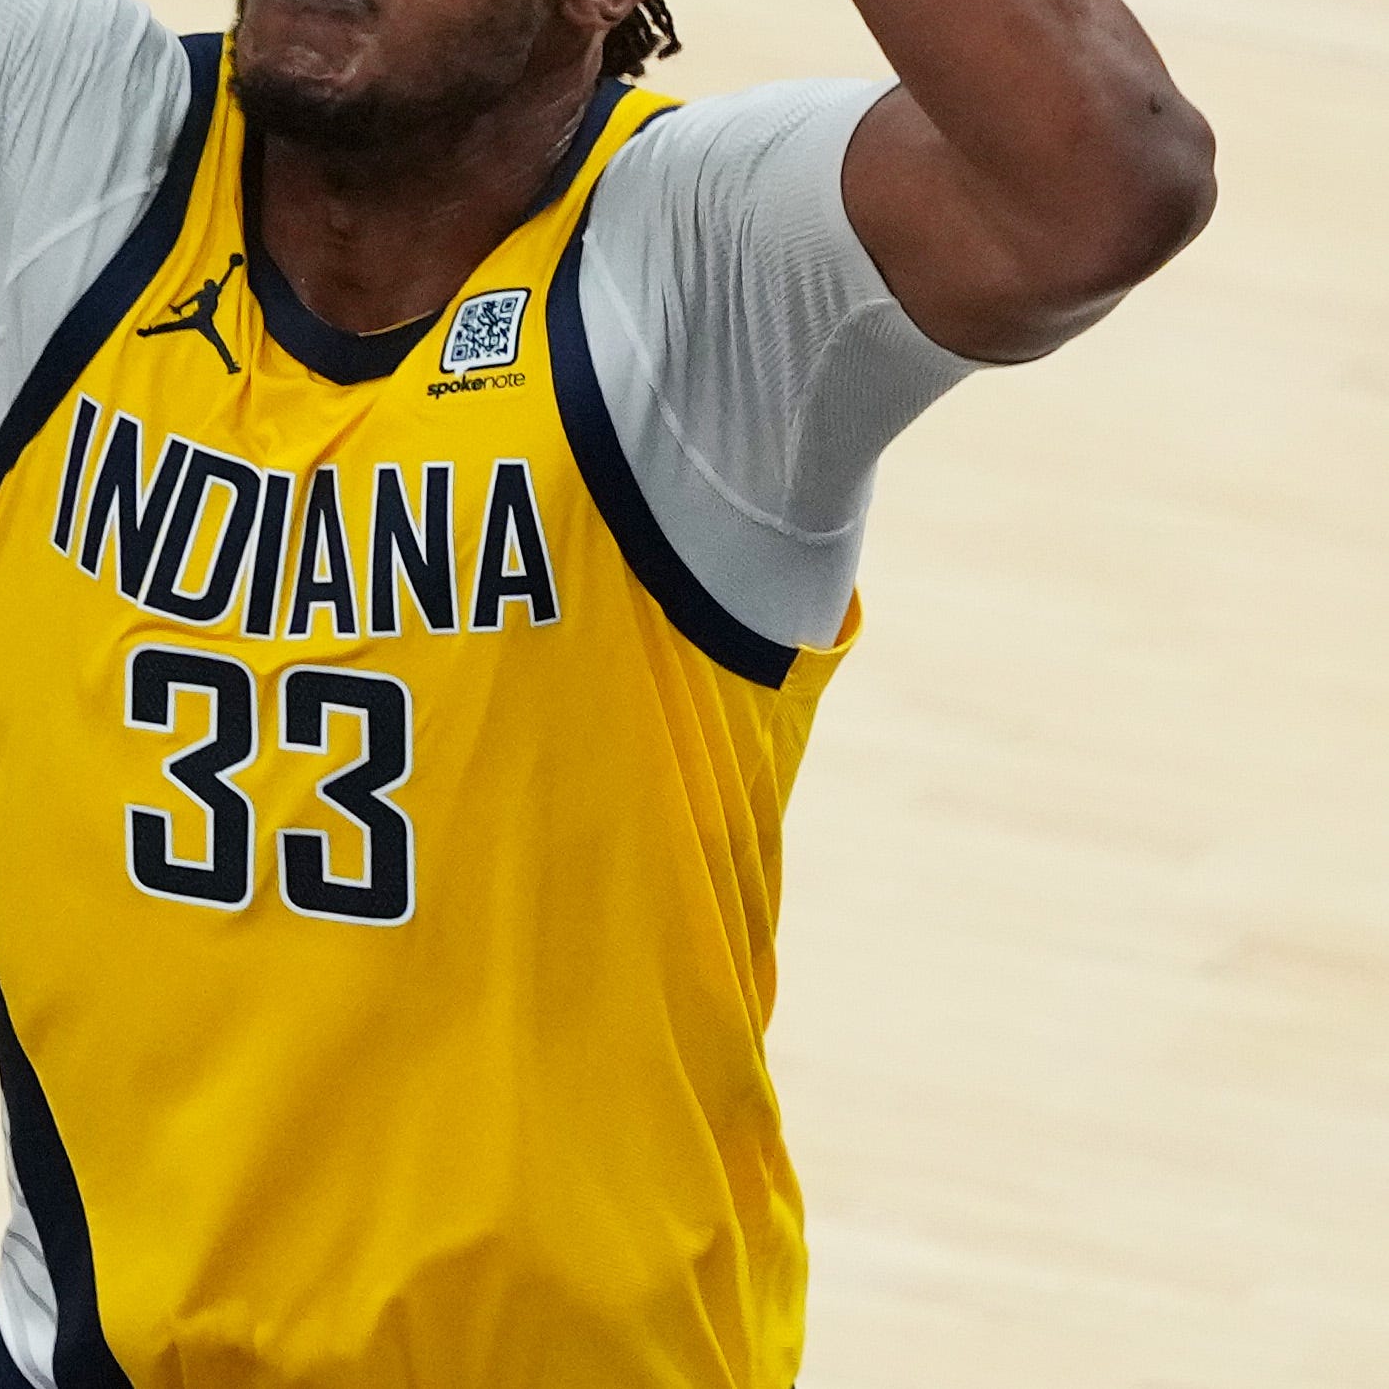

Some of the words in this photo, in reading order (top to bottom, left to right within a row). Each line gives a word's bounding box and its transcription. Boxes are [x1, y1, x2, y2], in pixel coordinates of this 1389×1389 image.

[426, 372, 525, 399] spokenote
[50, 392, 561, 639] INDIANA
[125, 643, 415, 927] 33
